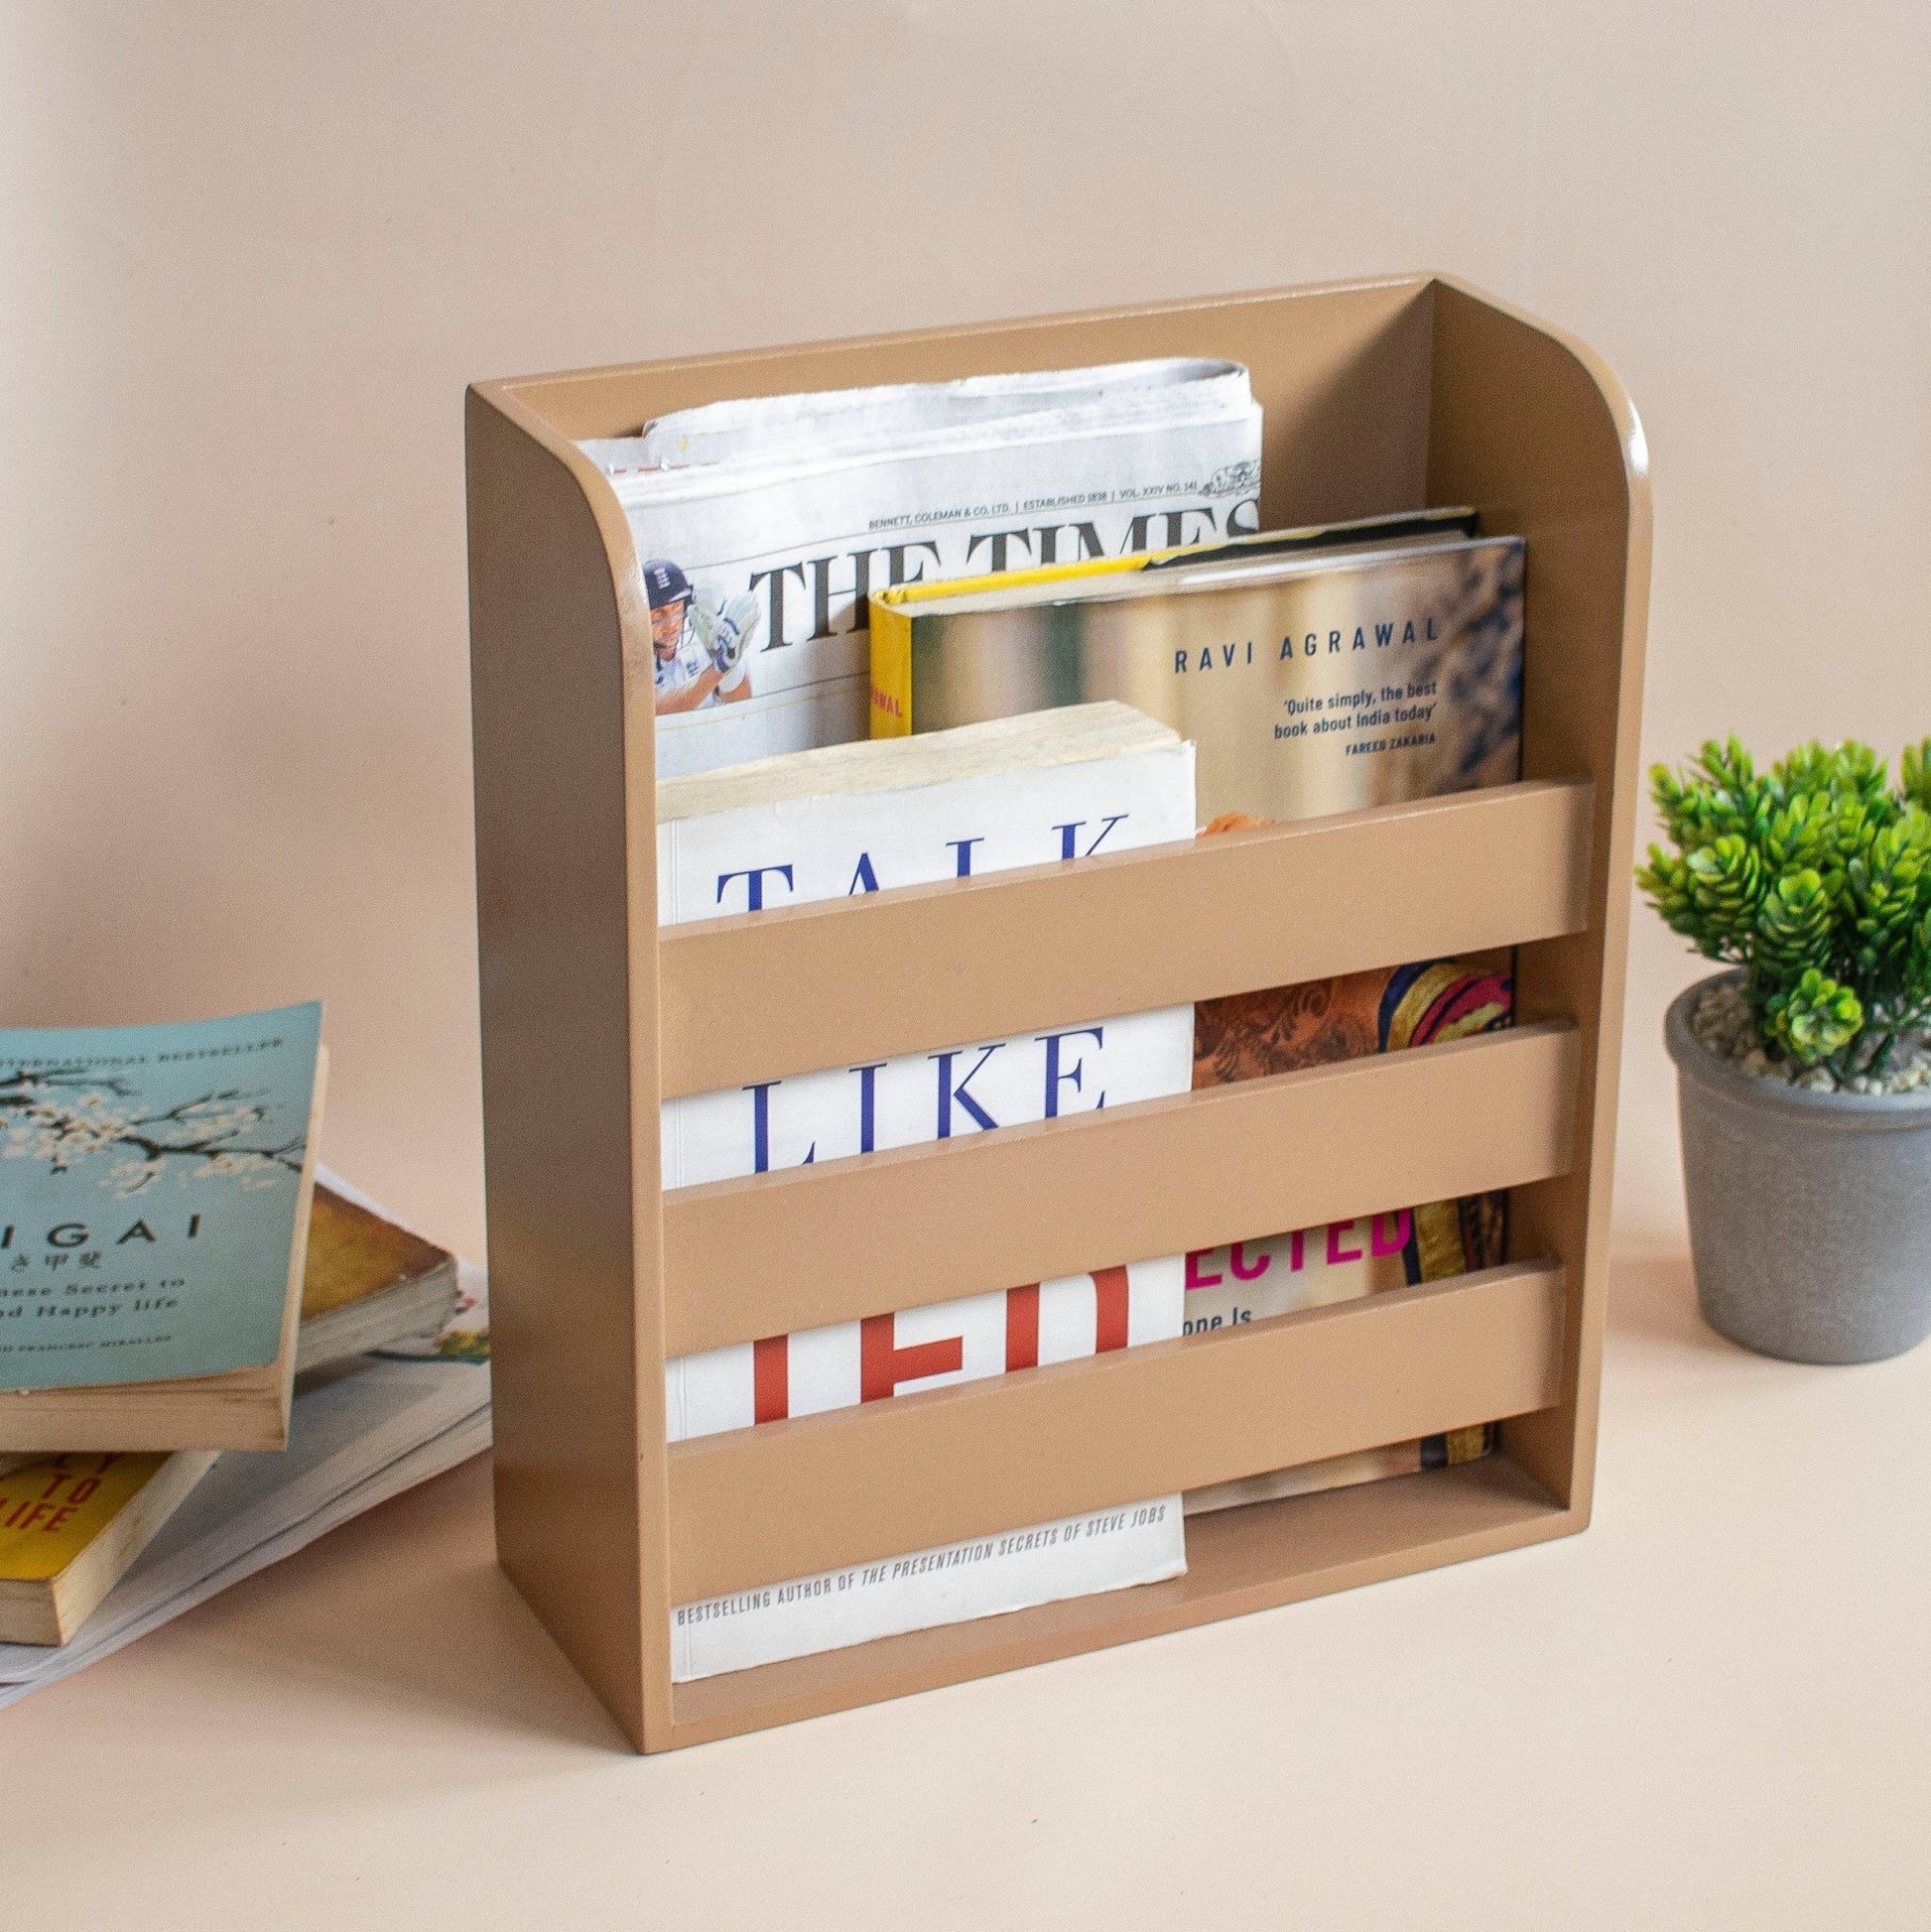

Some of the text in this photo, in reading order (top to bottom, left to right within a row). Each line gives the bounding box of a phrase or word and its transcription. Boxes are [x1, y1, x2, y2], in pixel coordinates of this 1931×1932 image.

[868, 514, 913, 531] BENNETT,
[915, 508, 962, 524] COLEMAN
[1023, 493, 1086, 511] ESTABLISHED
[1088, 491, 1108, 503] 1838
[749, 539, 942, 655] THE
[1175, 618, 1439, 674] RAVI AGRAWAL
[1327, 690, 1377, 712] simply,
[1380, 685, 1403, 702] the
[1406, 681, 1437, 699] best
[1274, 723, 1308, 740] book
[1313, 715, 1352, 735] about
[1356, 709, 1390, 729] India
[1346, 732, 1437, 756] FAREED ZAKARIA
[741, 1026, 1106, 1176] LIKE
[0, 1213, 202, 1250] IGAI
[65, 1282, 147, 1296] Secret
[160, 1277, 186, 1289] to
[37, 1302, 123, 1320] Happy
[134, 1295, 180, 1313] life
[41, 1474, 102, 1505] TO
[677, 1503, 1168, 1628] BESTSELLING AUTHOR OF THE PRESENTATION SECRETS OF STEVE JOBS
